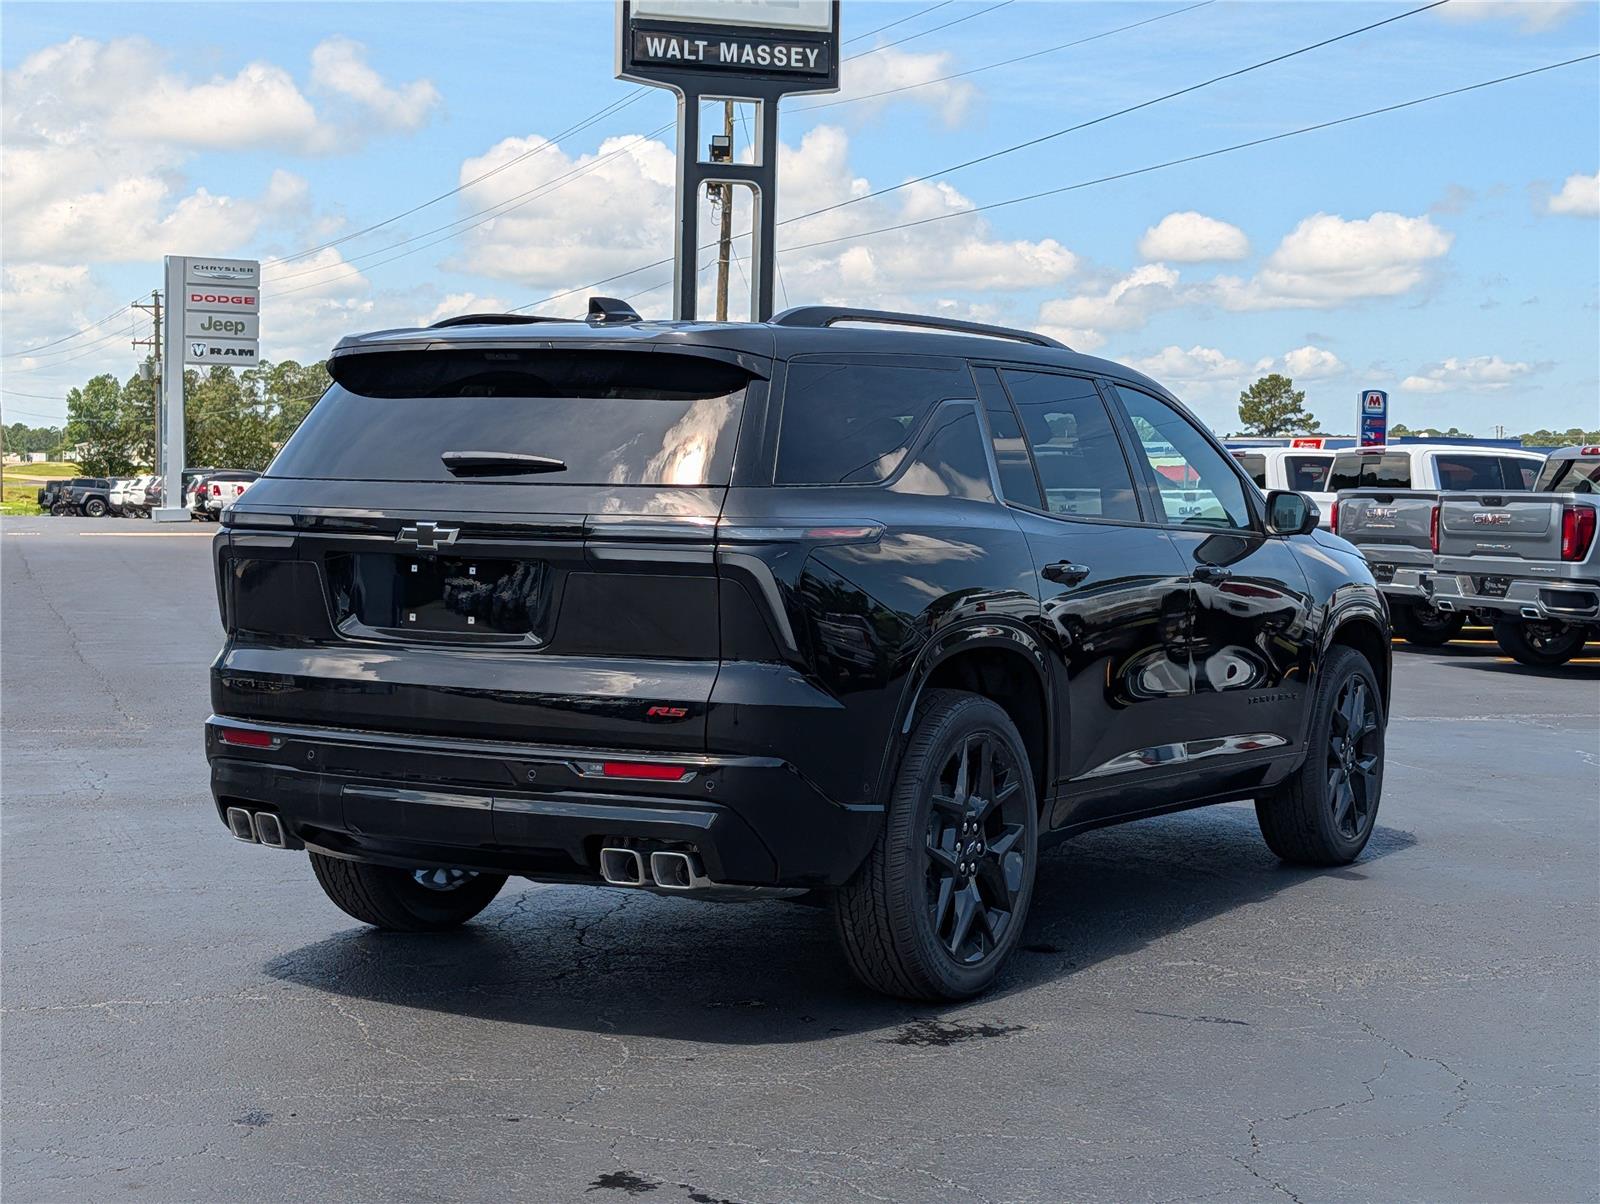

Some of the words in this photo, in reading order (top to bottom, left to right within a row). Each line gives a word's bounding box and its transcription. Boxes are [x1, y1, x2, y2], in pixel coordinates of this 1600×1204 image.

[646, 36, 708, 61] WALT
[719, 41, 819, 68] MASSEY
[193, 264, 254, 273] CHRYSLER
[191, 294, 255, 305] DODGE
[200, 315, 246, 336] Jeep
[209, 347, 255, 357] RAM
[1472, 512, 1512, 526] GMC
[647, 706, 689, 717] RS
